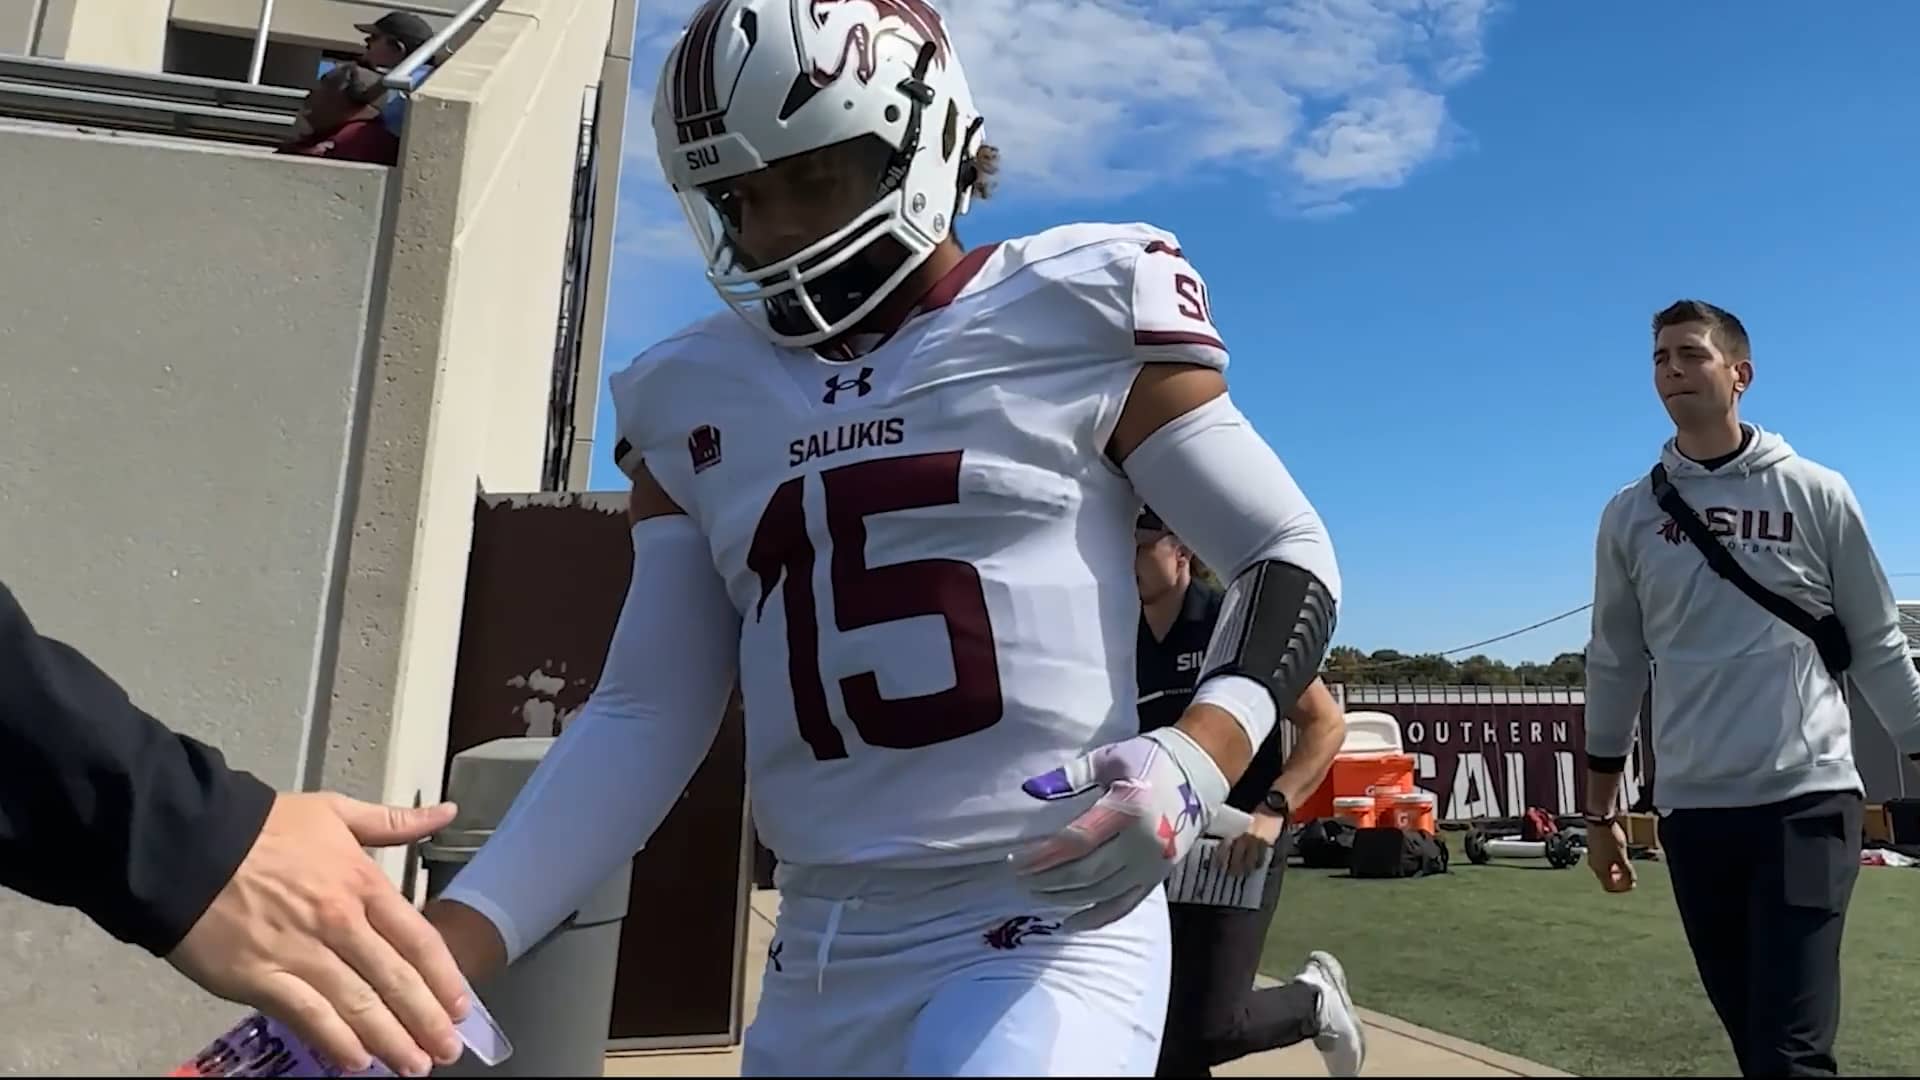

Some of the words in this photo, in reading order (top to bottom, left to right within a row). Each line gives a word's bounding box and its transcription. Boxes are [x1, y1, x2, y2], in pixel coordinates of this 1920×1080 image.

[686, 144, 720, 170] SIU
[789, 417, 905, 468] SALUKIS
[1705, 506, 1793, 543] SIU
[1726, 540, 1791, 558] OTBALL
[746, 448, 1004, 761] 15
[1407, 721, 1568, 744] OUTHERN
